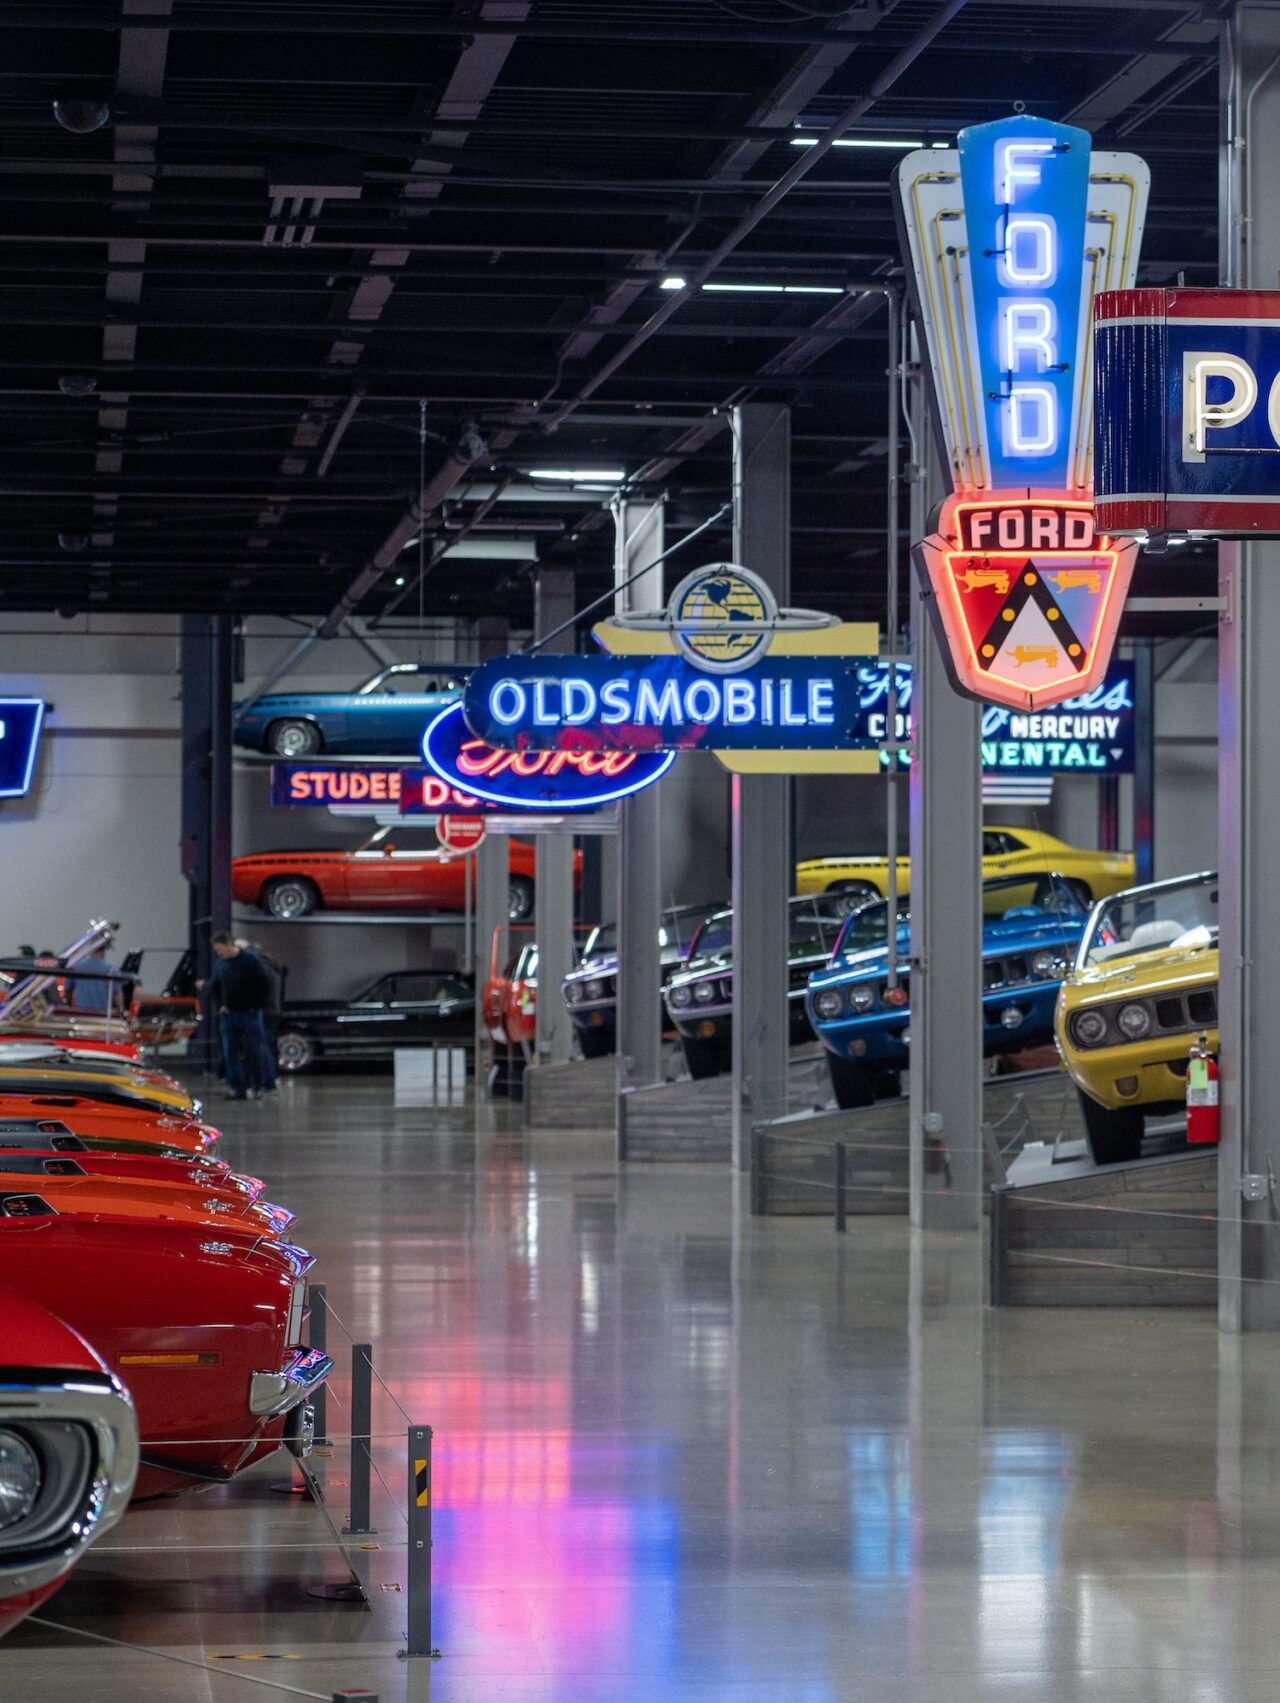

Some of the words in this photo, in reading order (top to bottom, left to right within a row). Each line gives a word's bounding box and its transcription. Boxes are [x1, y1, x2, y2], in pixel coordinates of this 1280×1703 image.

[994, 136, 1060, 458] FORD
[970, 509, 1094, 548] FORD
[489, 677, 835, 727] OLDSMOBILE
[1010, 715, 1120, 739] MERCURY
